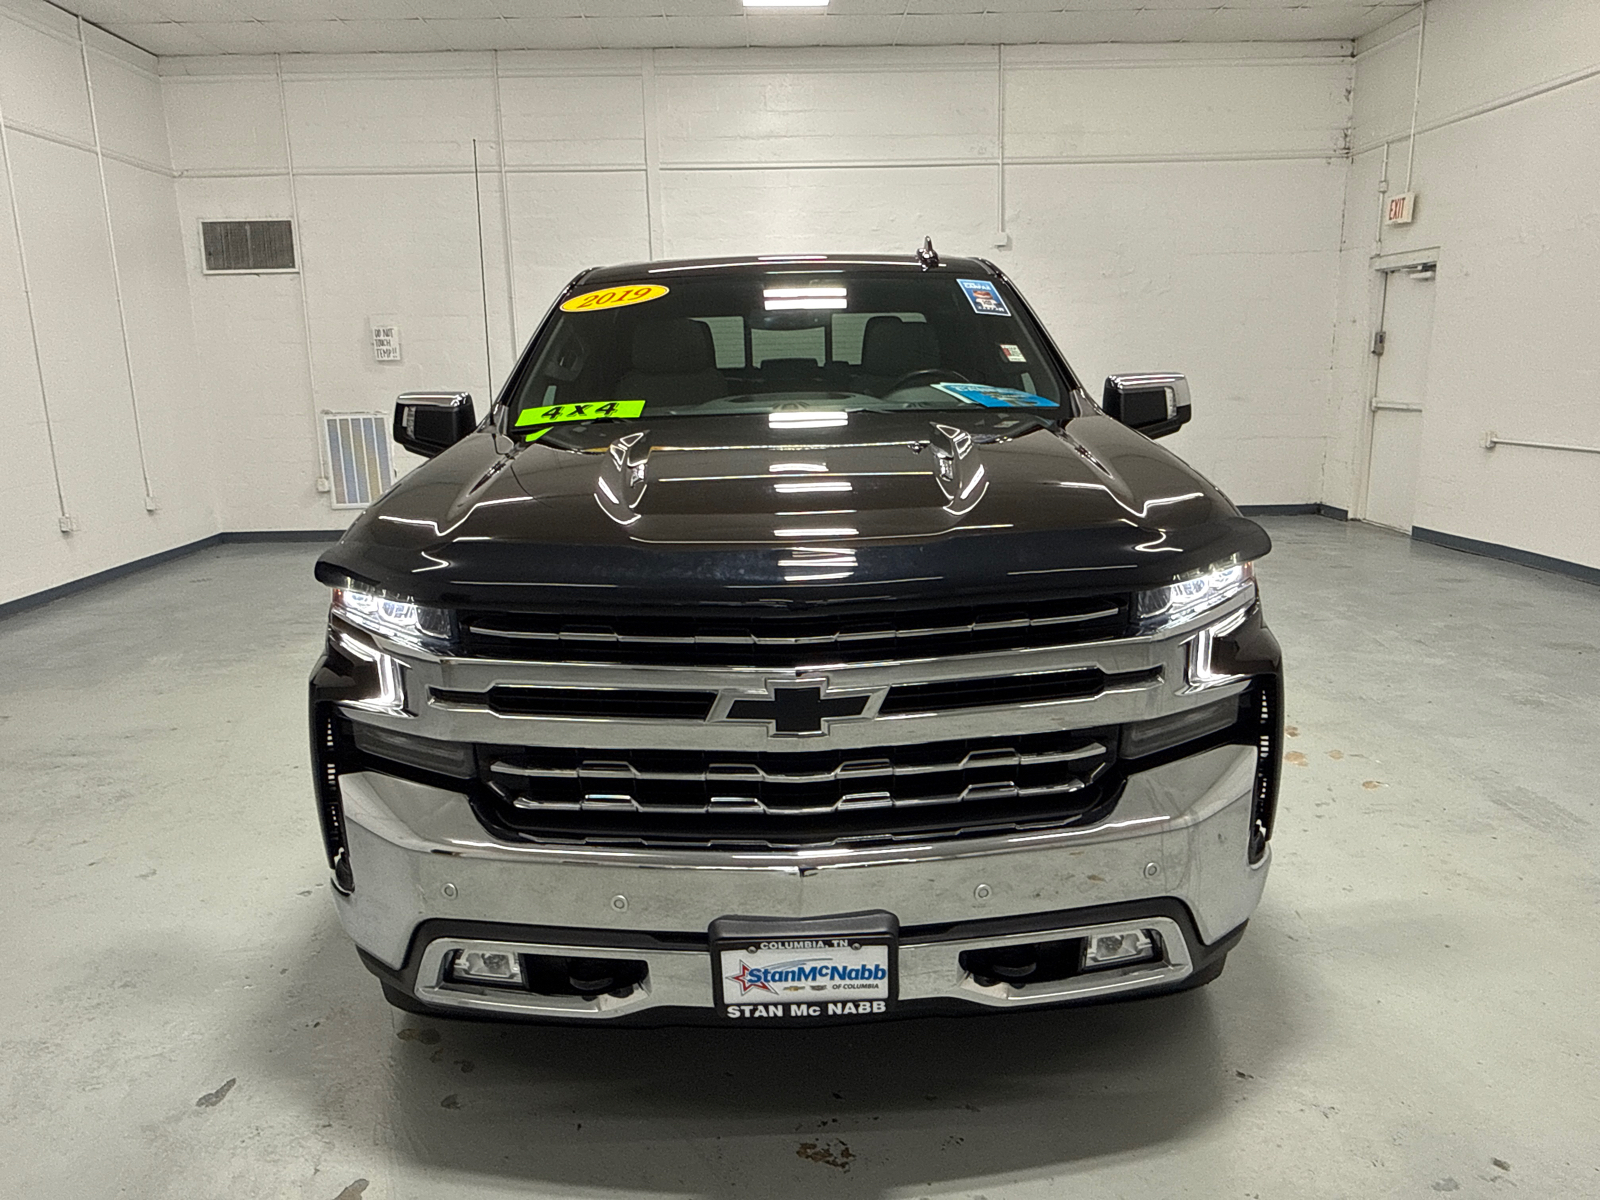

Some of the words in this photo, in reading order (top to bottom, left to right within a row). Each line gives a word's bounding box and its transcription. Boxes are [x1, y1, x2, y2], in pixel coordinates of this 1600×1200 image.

[1389, 197, 1406, 220] EXIT
[577, 287, 652, 309] 2019
[374, 329, 381, 338] DO
[382, 328, 394, 338] NOT
[374, 339, 391, 347] TOUCH
[760, 941, 828, 950] COLUMBIA,
[832, 940, 849, 948] TN
[727, 1004, 783, 1018] STAN
[790, 1005, 821, 1017] Mc
[827, 1001, 887, 1016] NABB
